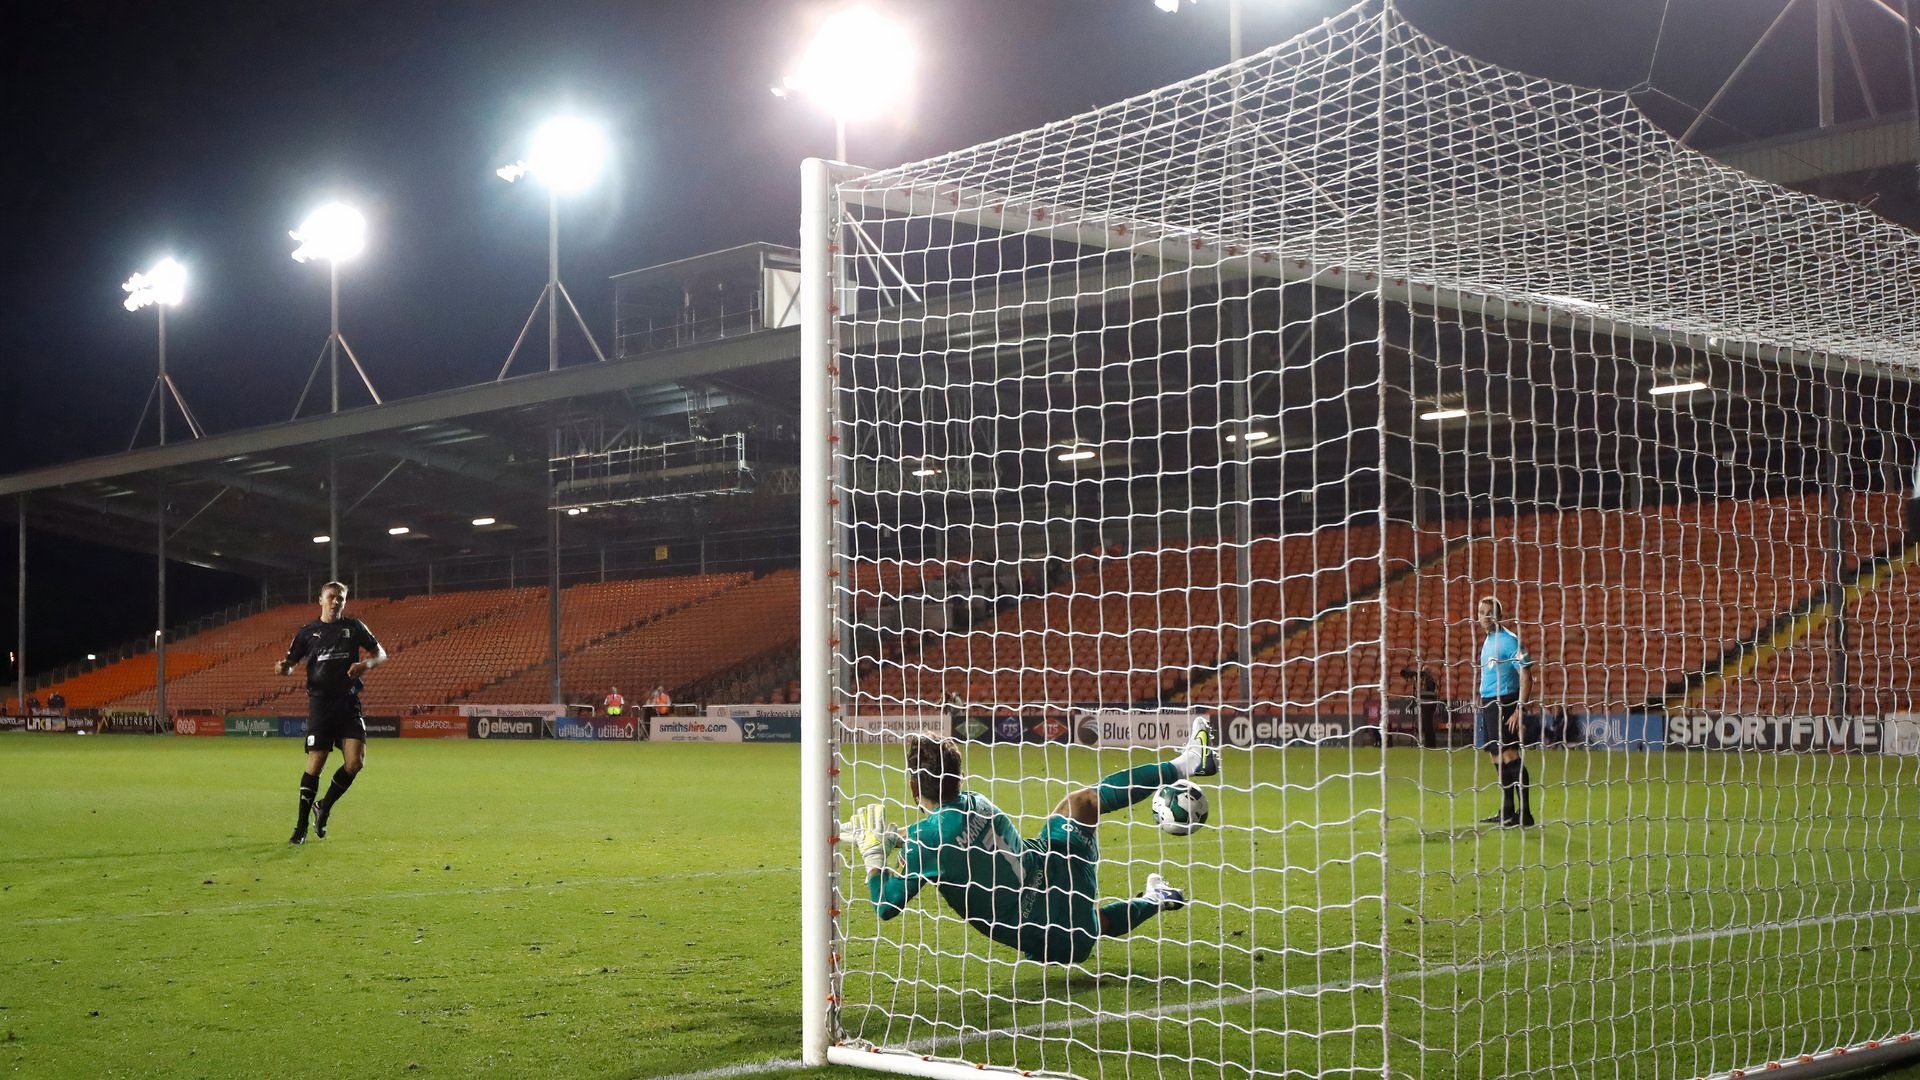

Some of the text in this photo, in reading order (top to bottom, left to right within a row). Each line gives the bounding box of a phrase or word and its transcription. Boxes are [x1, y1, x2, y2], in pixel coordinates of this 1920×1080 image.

[490, 718, 533, 734] eleven
[597, 723, 625, 738] utilita
[659, 720, 728, 733] smithshire.com
[1103, 722, 1171, 740] Blue CDM
[1255, 717, 1343, 739] eleven
[1669, 715, 1878, 745] SPORTFIVE
